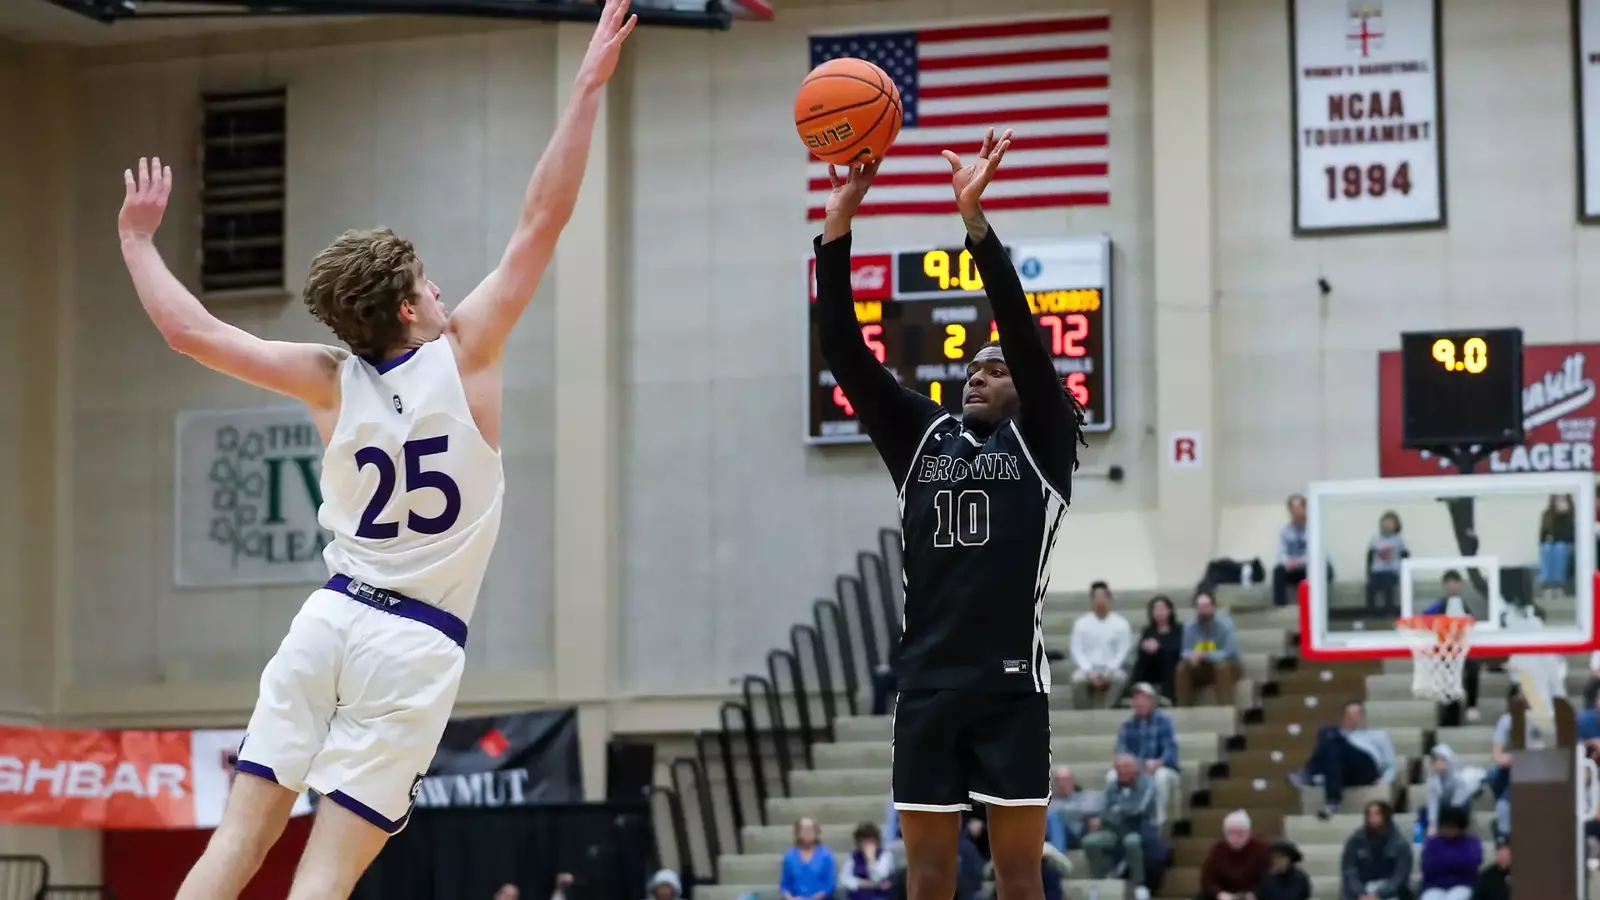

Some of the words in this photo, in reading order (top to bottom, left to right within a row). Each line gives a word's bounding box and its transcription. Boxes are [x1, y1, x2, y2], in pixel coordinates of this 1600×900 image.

[1327, 89, 1405, 122] NCAA
[1303, 121, 1431, 147] TOURNAMENT
[1323, 161, 1412, 201] 1994
[923, 248, 985, 292] 9.0
[943, 323, 966, 359] 2
[1039, 313, 1090, 357] 72
[1432, 337, 1487, 374] 9.0
[918, 452, 1021, 483] BROWN
[1174, 437, 1197, 463] R
[1489, 442, 1595, 473] LAGER
[354, 434, 462, 540] 25
[933, 489, 990, 548] 10
